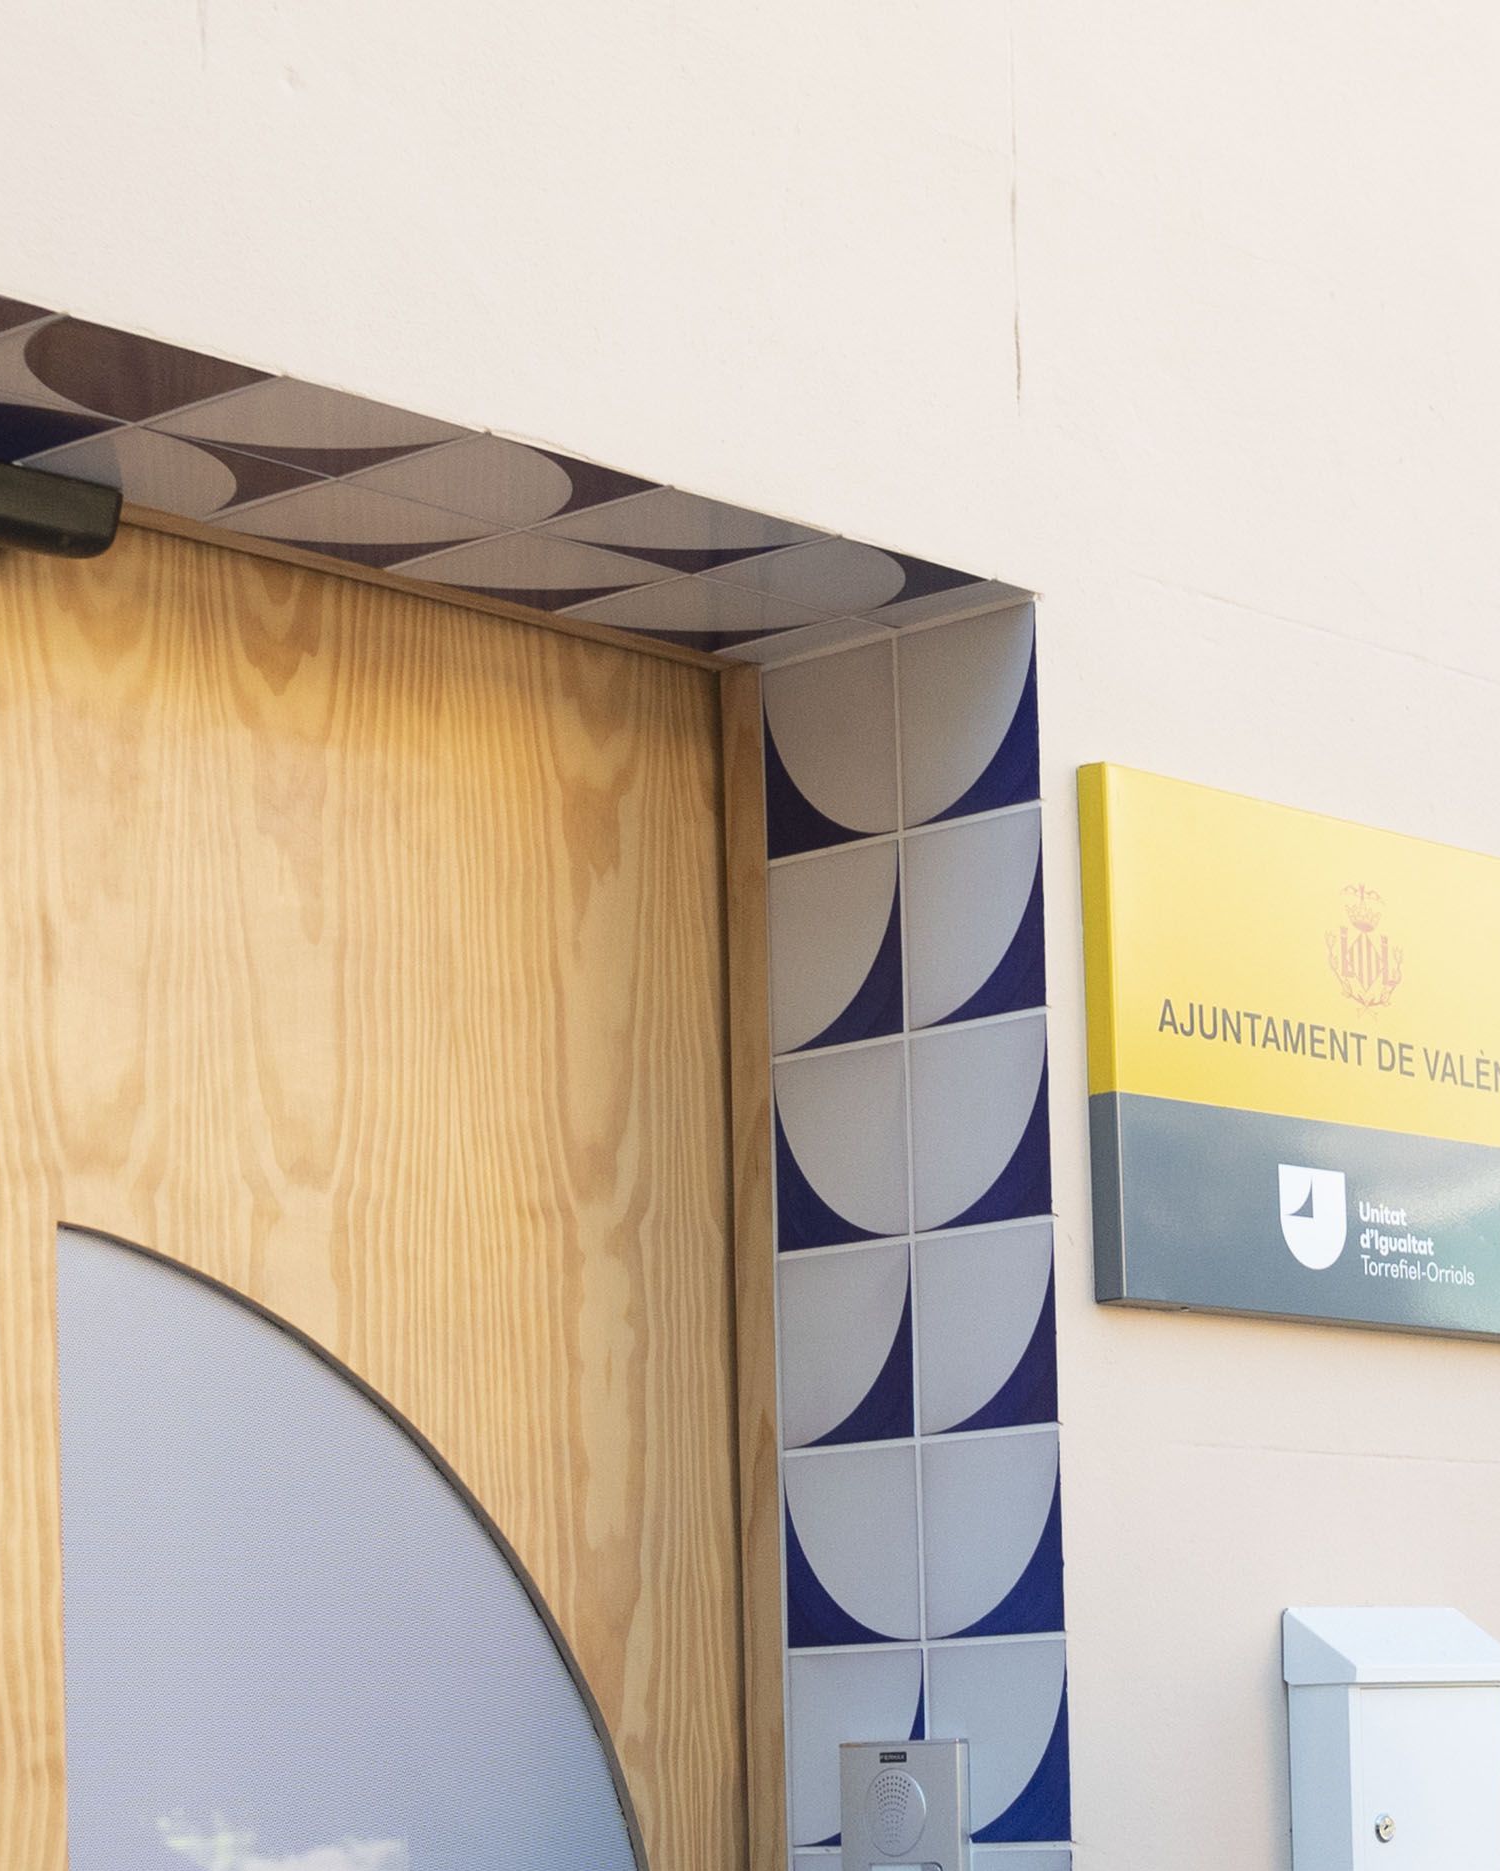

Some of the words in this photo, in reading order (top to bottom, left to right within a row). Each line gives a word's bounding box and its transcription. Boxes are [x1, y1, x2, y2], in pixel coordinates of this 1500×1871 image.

[1157, 998, 1368, 1067] AJUNTAMENT
[1376, 1037, 1416, 1078] DE
[1359, 1200, 1408, 1227] Unitat
[1359, 1227, 1435, 1257] d’Igualtat
[1360, 1253, 1476, 1287] Torrefiel-Orriols
